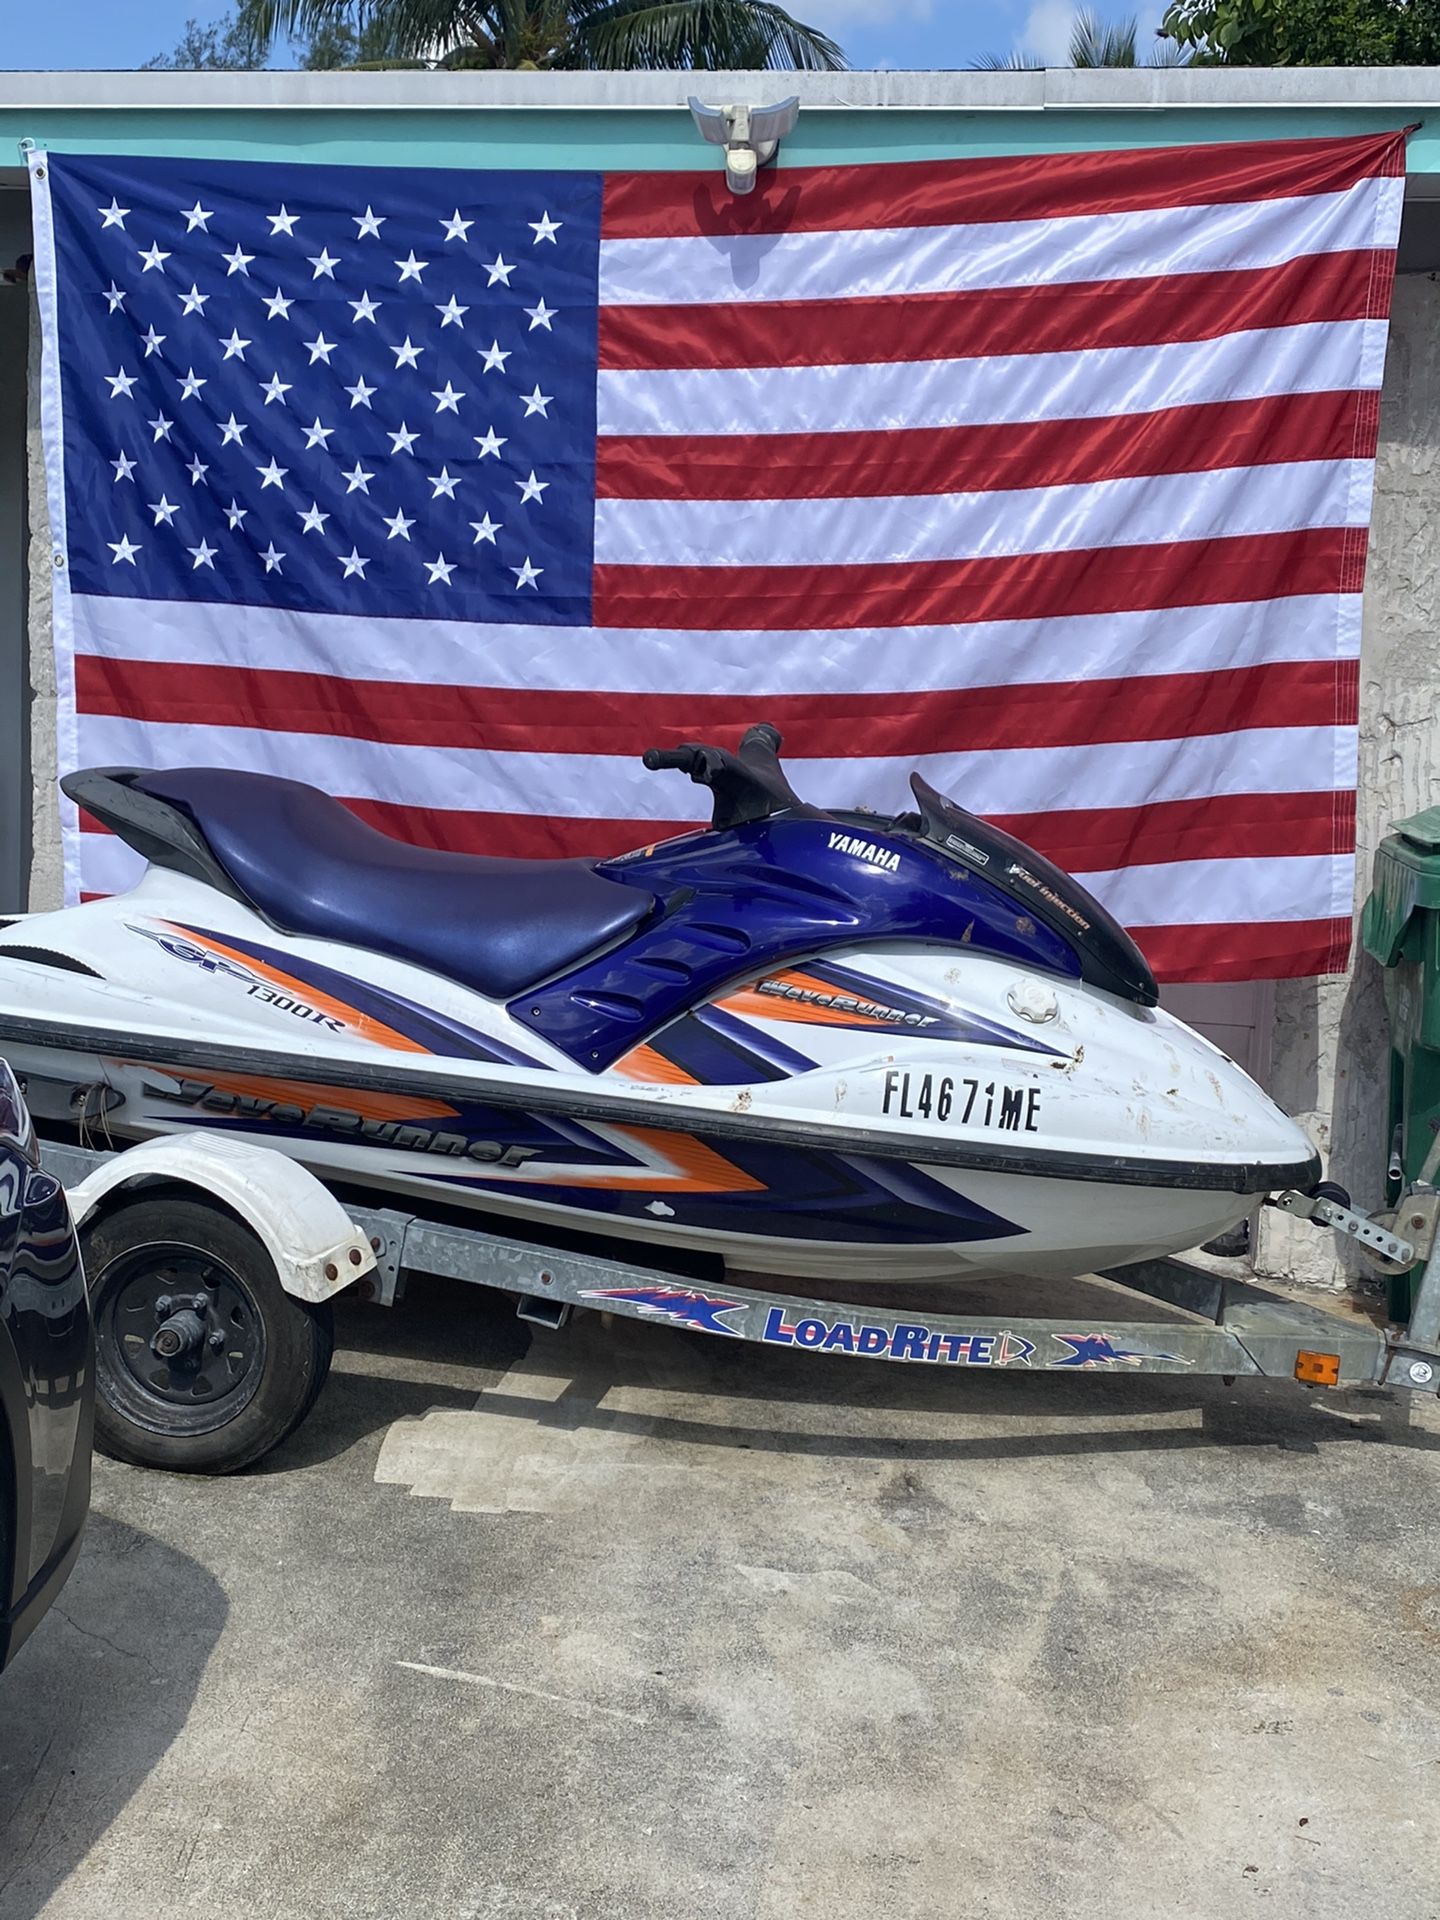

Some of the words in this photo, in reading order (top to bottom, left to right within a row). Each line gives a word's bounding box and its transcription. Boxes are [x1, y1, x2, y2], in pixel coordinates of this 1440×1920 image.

[827, 832, 901, 872] YAMAHA
[246, 984, 347, 1034] 1300R
[757, 980, 941, 1028] WaveRunner
[882, 1070, 1041, 1132] FL4671ME
